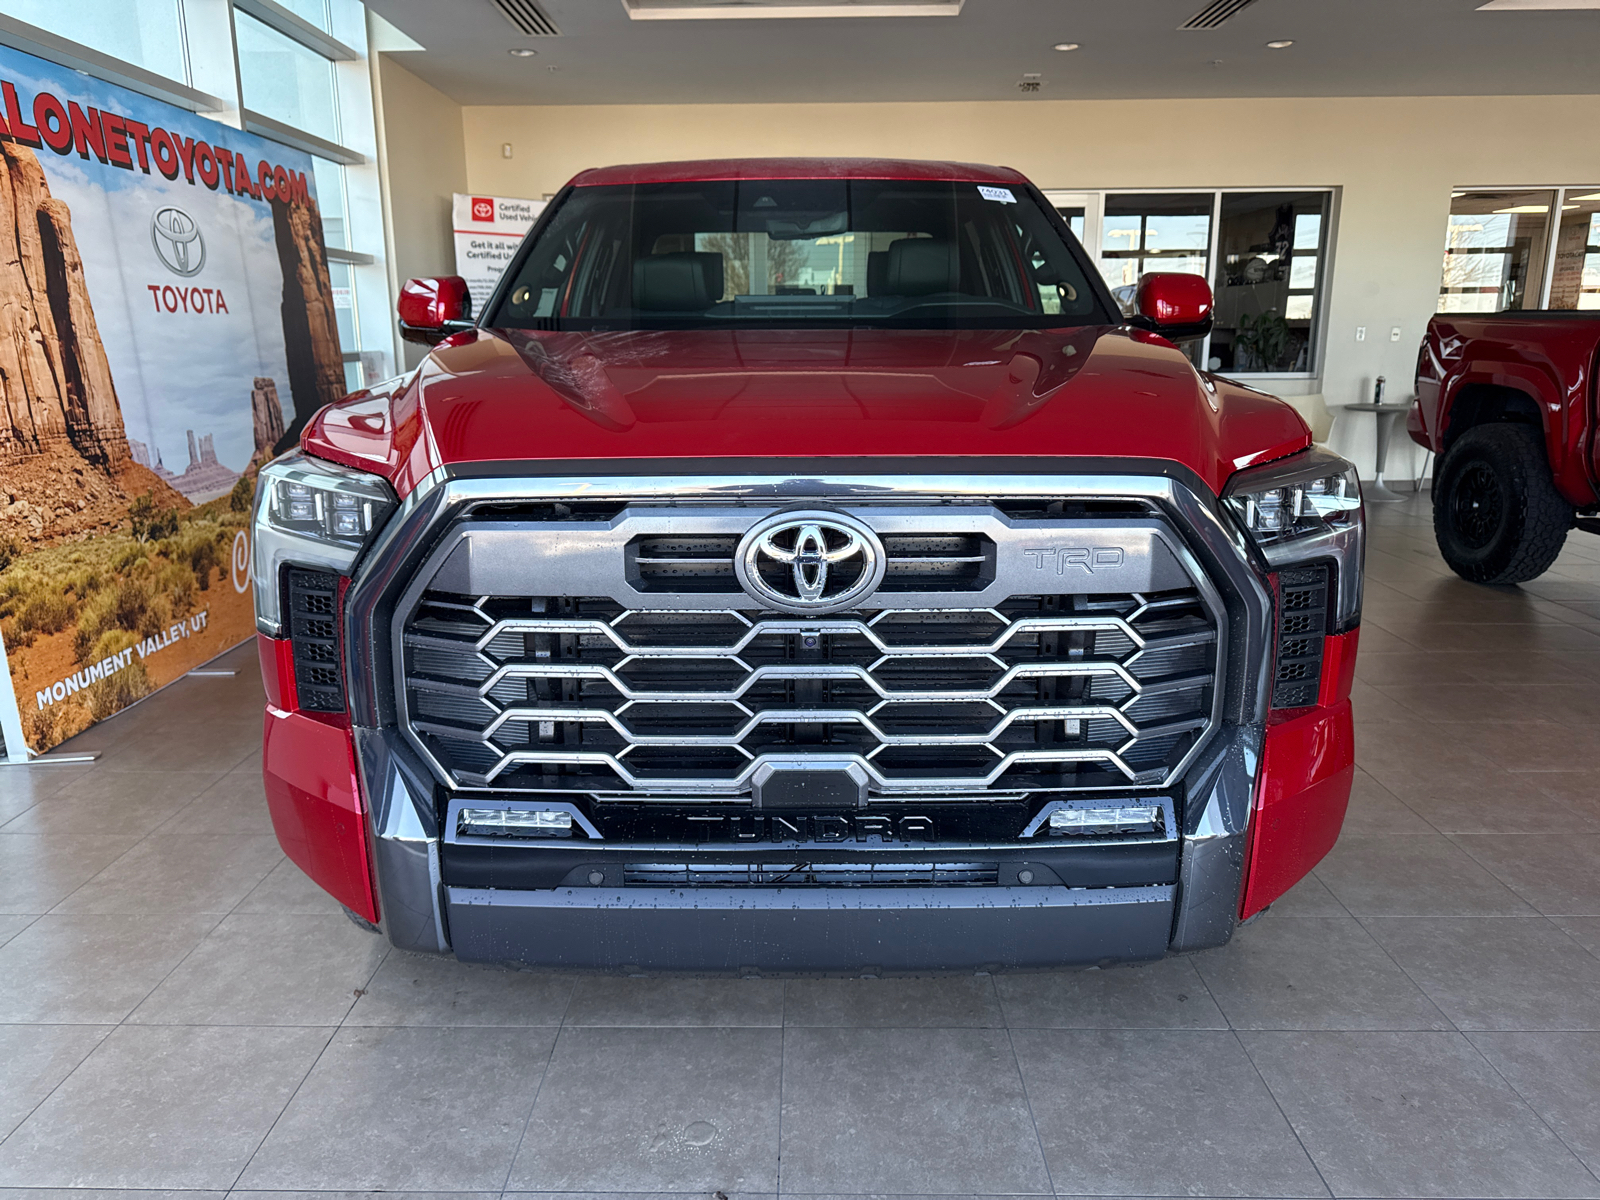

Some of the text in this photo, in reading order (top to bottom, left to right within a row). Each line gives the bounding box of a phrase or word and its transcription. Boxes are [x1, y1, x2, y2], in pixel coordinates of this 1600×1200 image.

[499, 203, 530, 213] Certified
[499, 212, 518, 221] Used
[470, 240, 485, 249] Get
[487, 241, 493, 249] it
[495, 241, 504, 250] all
[466, 250, 501, 260] Certified
[147, 284, 229, 315] TOYOTA
[1024, 547, 1124, 575] TRD
[36, 611, 207, 710] MONUMENT VALLEY, UT
[688, 816, 935, 843] TUNDRA
